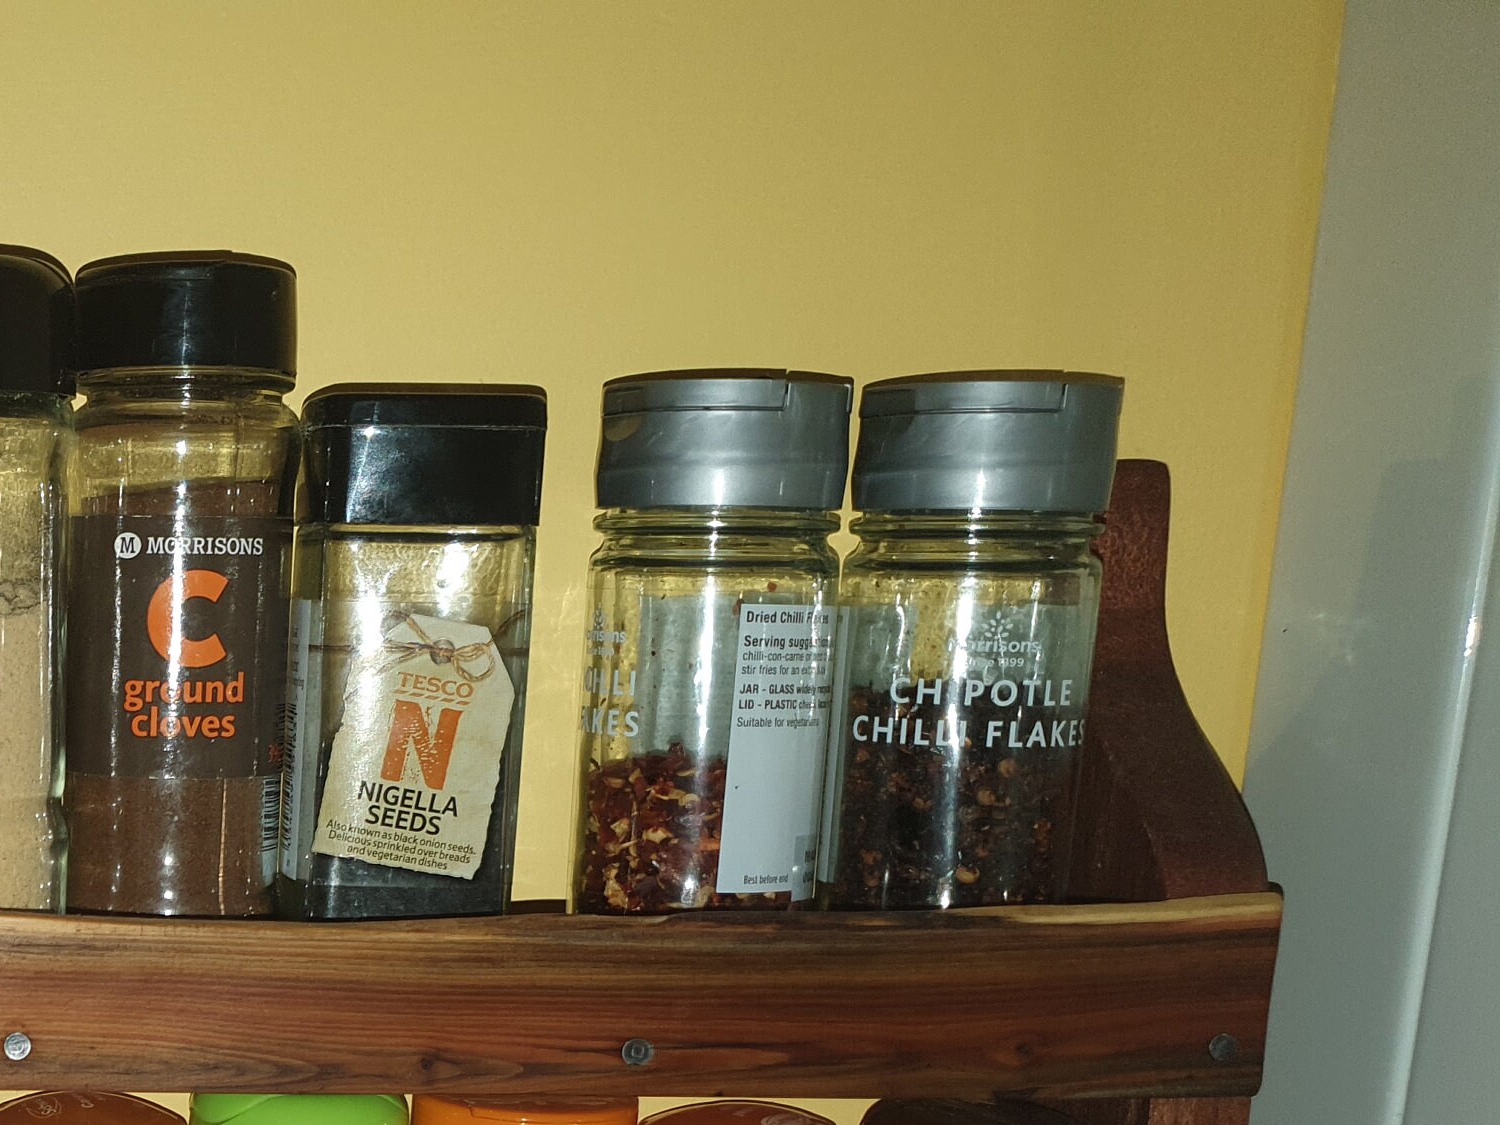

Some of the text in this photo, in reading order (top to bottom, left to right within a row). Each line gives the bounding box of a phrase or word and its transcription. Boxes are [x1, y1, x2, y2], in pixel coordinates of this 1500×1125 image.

[147, 537, 263, 555] MORRISONS
[147, 569, 229, 668] C
[747, 611, 777, 623] Dried
[781, 611, 803, 623] Chilli
[744, 635, 785, 649] Serving
[742, 665, 756, 675] stir
[760, 665, 776, 674] fries
[780, 665, 789, 674] for
[124, 672, 245, 711] ground
[398, 672, 474, 698] TESCO
[740, 684, 759, 694] JAR
[769, 684, 794, 694] GLASS
[739, 700, 754, 709] LID
[765, 700, 796, 709] PLASTIC
[131, 707, 236, 737] cloves
[582, 705, 639, 737] AKES
[737, 717, 771, 727] Suitable
[775, 718, 785, 727] for
[853, 715, 1085, 748] CHILLI FLAKES
[380, 699, 464, 791] N
[358, 781, 458, 817] NIGELLA
[365, 805, 441, 835] SEEDS
[326, 820, 476, 854] Also known as black onion seeds.
[328, 830, 471, 864] Delicious sprinkled over breads
[347, 845, 448, 870] and vegetarian dishes
[744, 874, 788, 884] Best before end
